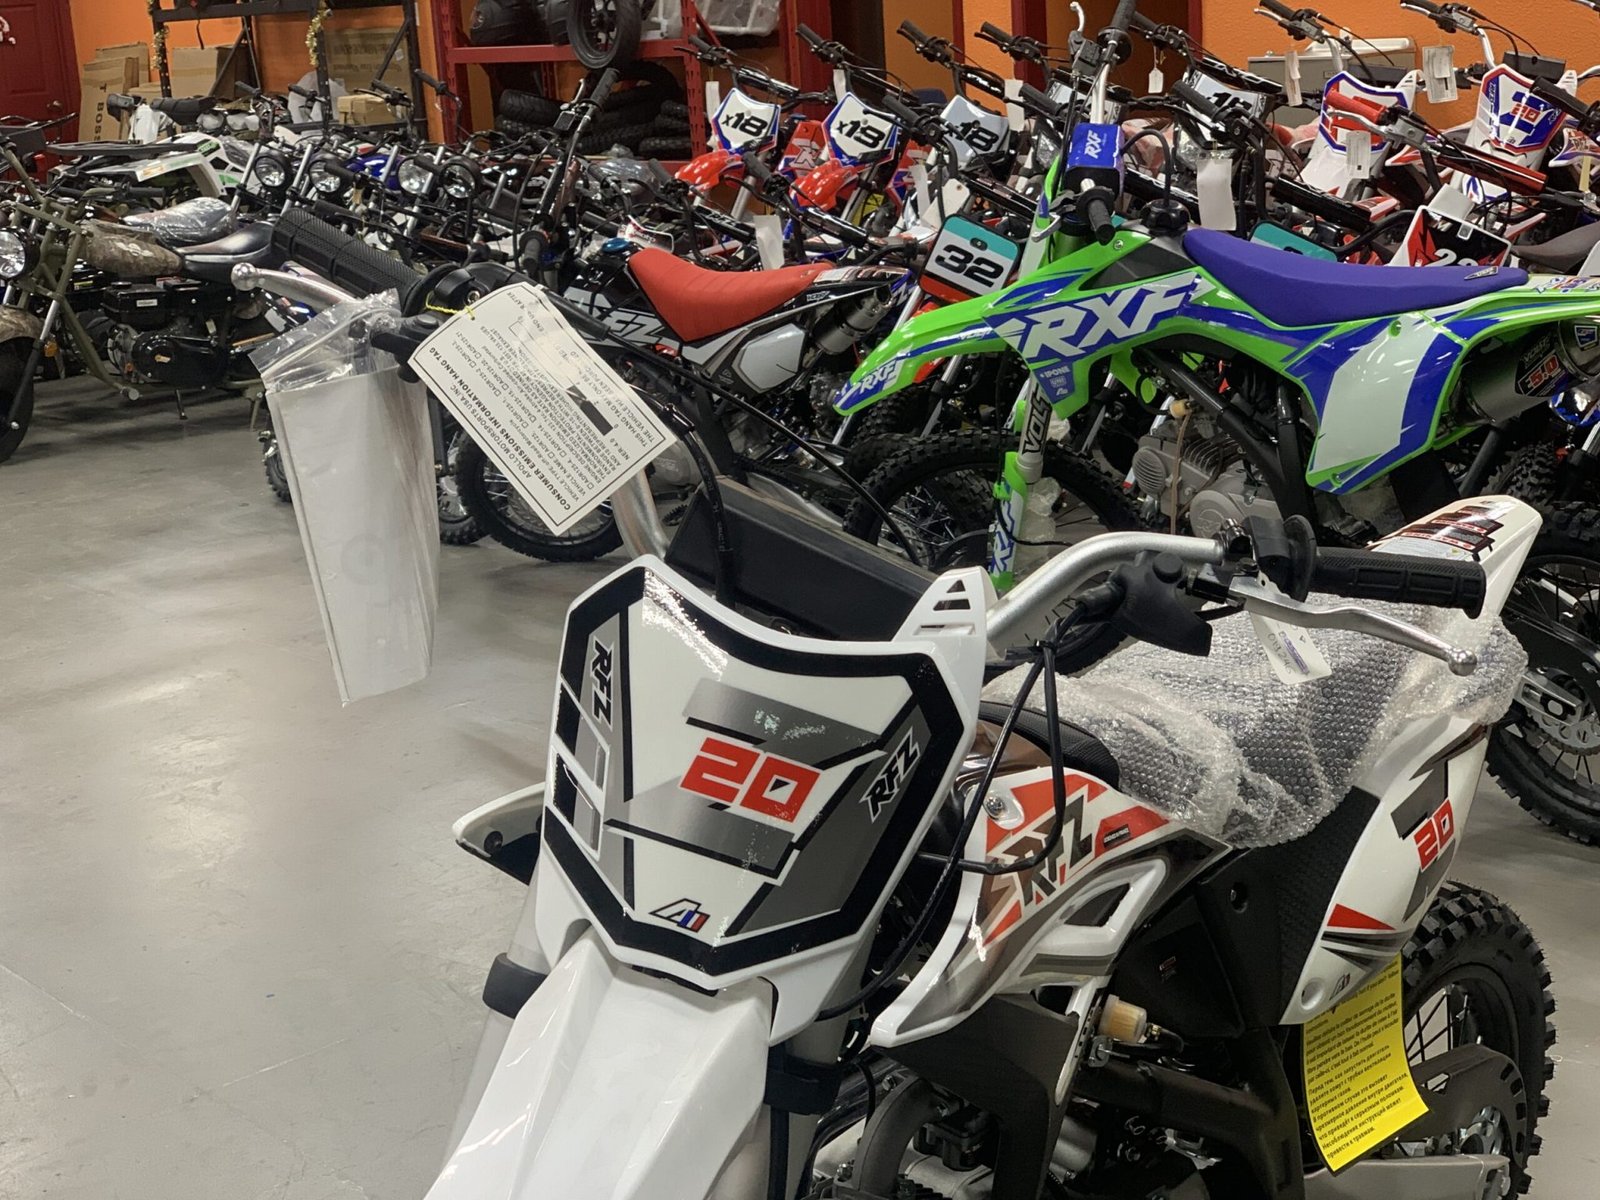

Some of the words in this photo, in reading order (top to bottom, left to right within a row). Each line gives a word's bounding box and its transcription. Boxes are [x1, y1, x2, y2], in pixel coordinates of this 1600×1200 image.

[1084, 130, 1103, 159] RXF
[935, 244, 1004, 288] 32
[1022, 270, 1198, 358] RXF
[428, 346, 442, 360] TAG
[439, 358, 459, 380] HANG
[511, 369, 532, 393] DEFINED
[859, 360, 898, 394] RXF
[457, 378, 502, 429] INFORMATION
[529, 390, 538, 400] AS
[530, 381, 550, 404] AGENCY
[536, 398, 549, 412] RATE
[554, 390, 574, 412] HIGHER
[549, 403, 576, 434] PROTECTION
[609, 404, 622, 417] TAG
[620, 403, 644, 430] VEHICLE
[470, 408, 510, 454] MOTORSPORTS
[547, 411, 570, 437] EMISSION
[572, 411, 606, 450] REPRESENTING
[620, 416, 636, 434] HANG
[642, 428, 654, 442] THE
[499, 428, 536, 469] EMISSIONS
[567, 435, 596, 468] NORMALIZED
[579, 428, 601, 453] BETWEEN
[634, 432, 648, 447] THIS
[507, 452, 532, 479] APOLLO
[574, 432, 611, 475] ENVIRONMENTAL
[599, 451, 616, 471] RANGE
[608, 454, 621, 467] AND
[565, 473, 586, 496] VEHICLE
[582, 463, 601, 483] ENGINE
[594, 466, 606, 479] THE
[533, 467, 571, 511] CONSUMER
[559, 478, 579, 501] VEHICLE
[592, 635, 616, 732] RFZ
[679, 736, 822, 824] 20
[859, 727, 921, 824] RFZ
[1413, 798, 1455, 872] 20
